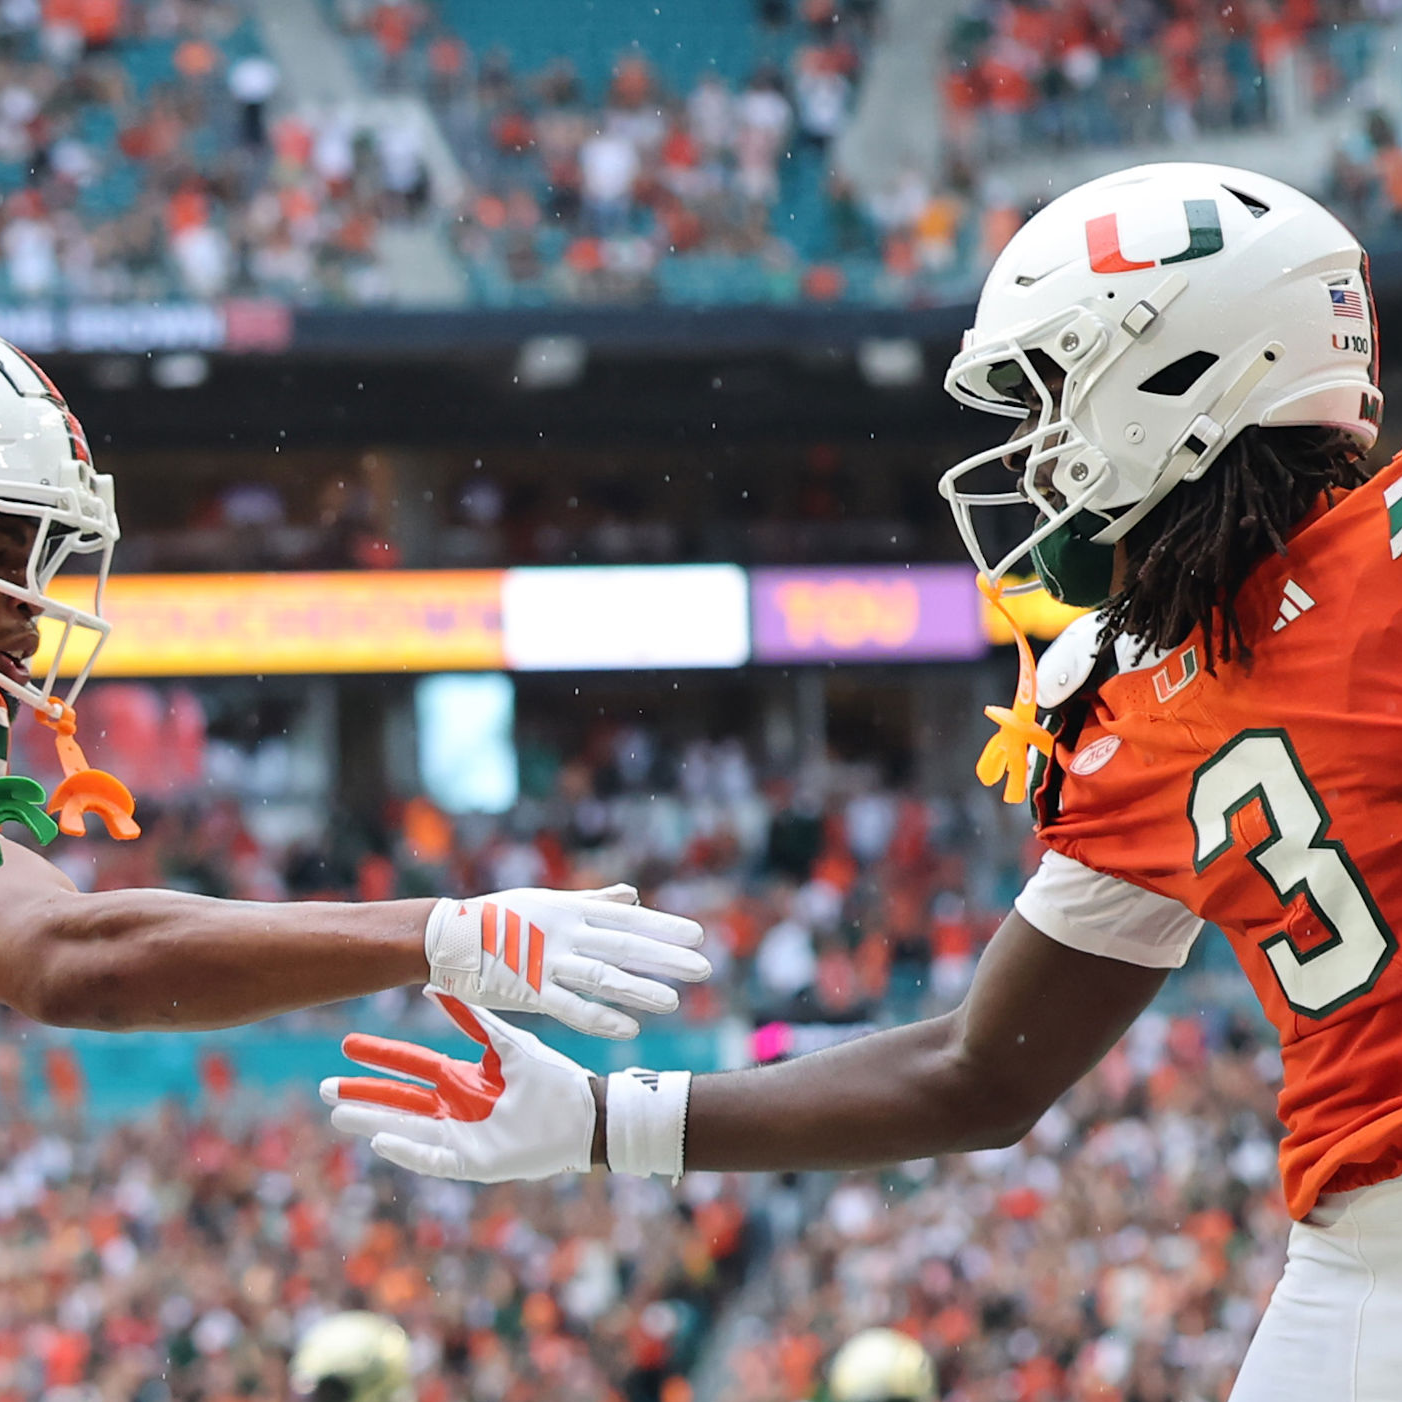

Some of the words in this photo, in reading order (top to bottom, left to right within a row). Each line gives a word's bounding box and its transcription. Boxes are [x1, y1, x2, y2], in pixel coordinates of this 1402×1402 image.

[1084, 199, 1224, 274] U
[1352, 336, 1368, 354] 100
[1152, 645, 1198, 703] U
[1187, 728, 1398, 1020] 3
